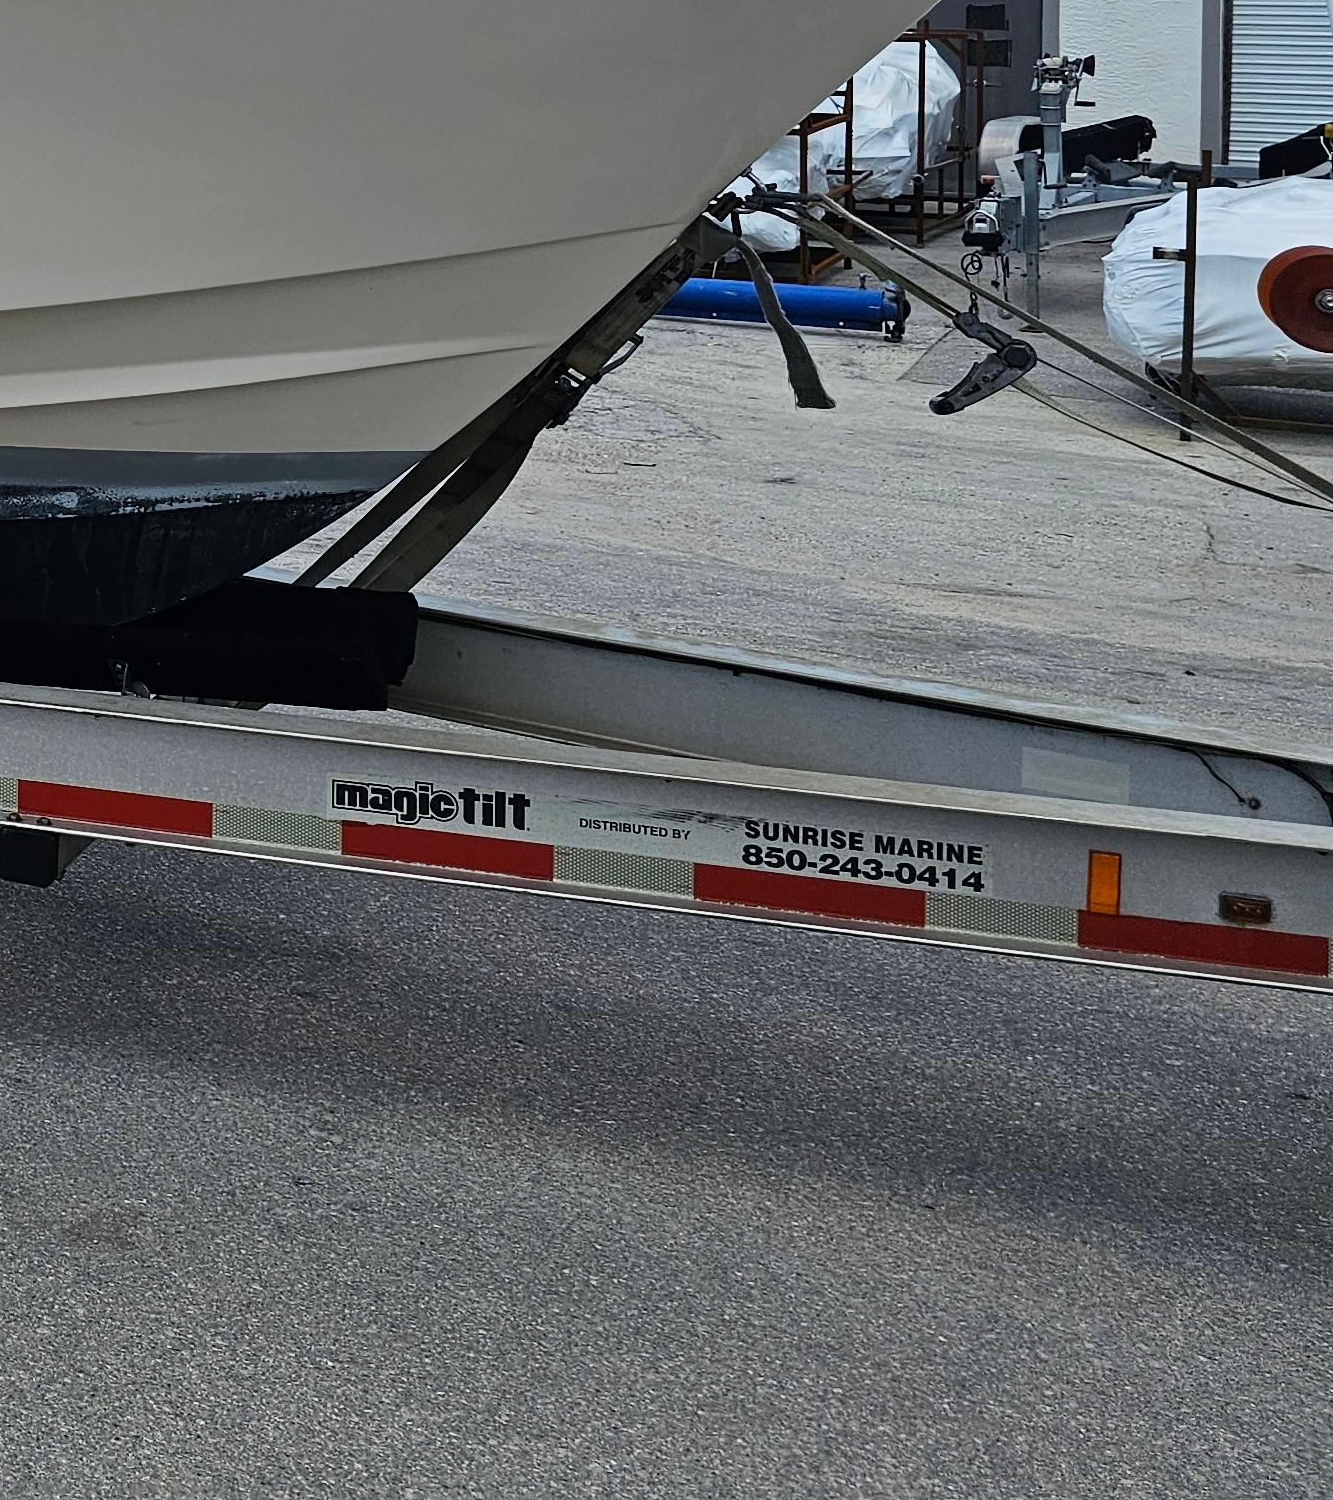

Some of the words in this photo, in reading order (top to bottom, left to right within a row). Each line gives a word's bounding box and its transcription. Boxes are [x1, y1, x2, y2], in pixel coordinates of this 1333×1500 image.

[579, 817, 668, 838] DISTRIBUTED
[672, 828, 691, 840] BY
[744, 819, 864, 851] SUNRISE
[874, 834, 983, 865] MARINE
[741, 844, 985, 892] 850-243-0414
